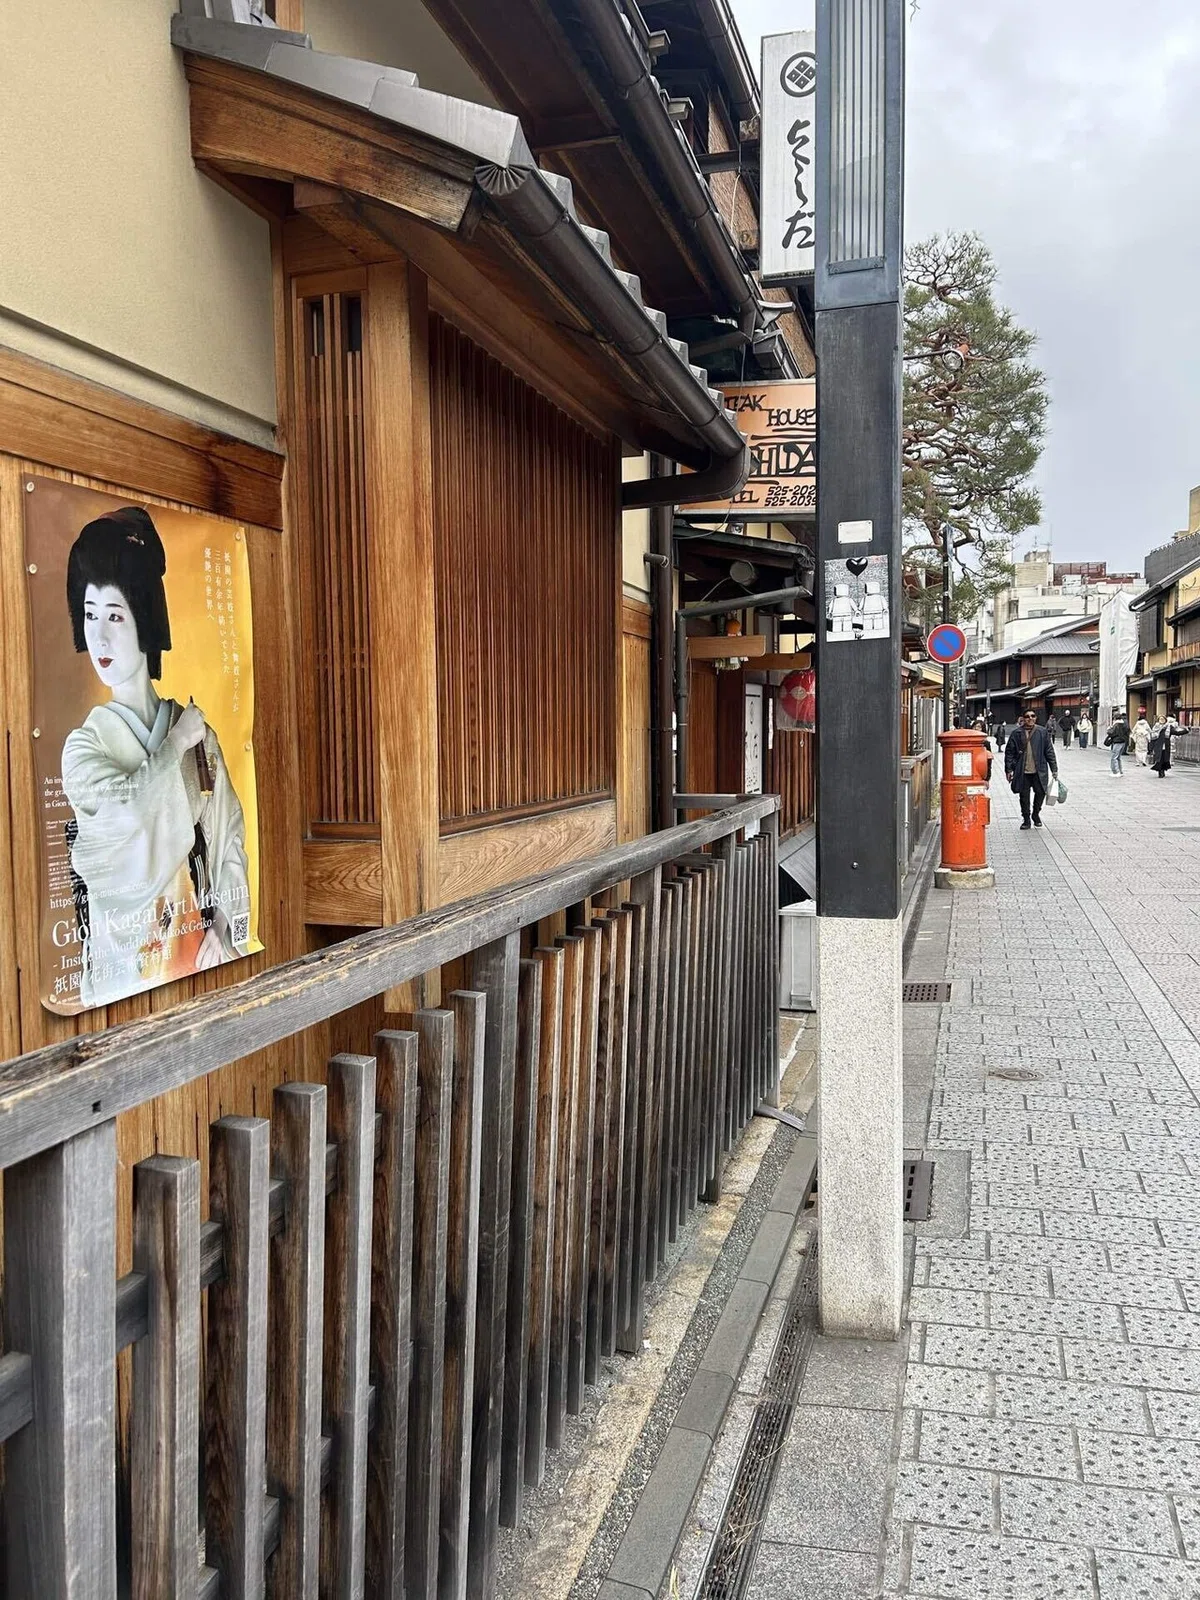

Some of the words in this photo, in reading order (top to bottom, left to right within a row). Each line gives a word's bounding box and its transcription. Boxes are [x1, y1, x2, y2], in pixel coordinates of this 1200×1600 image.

[52, 917, 99, 948] Gion
[104, 898, 159, 934] Kagai
[160, 897, 188, 921] Art
[188, 884, 250, 914] Museum
